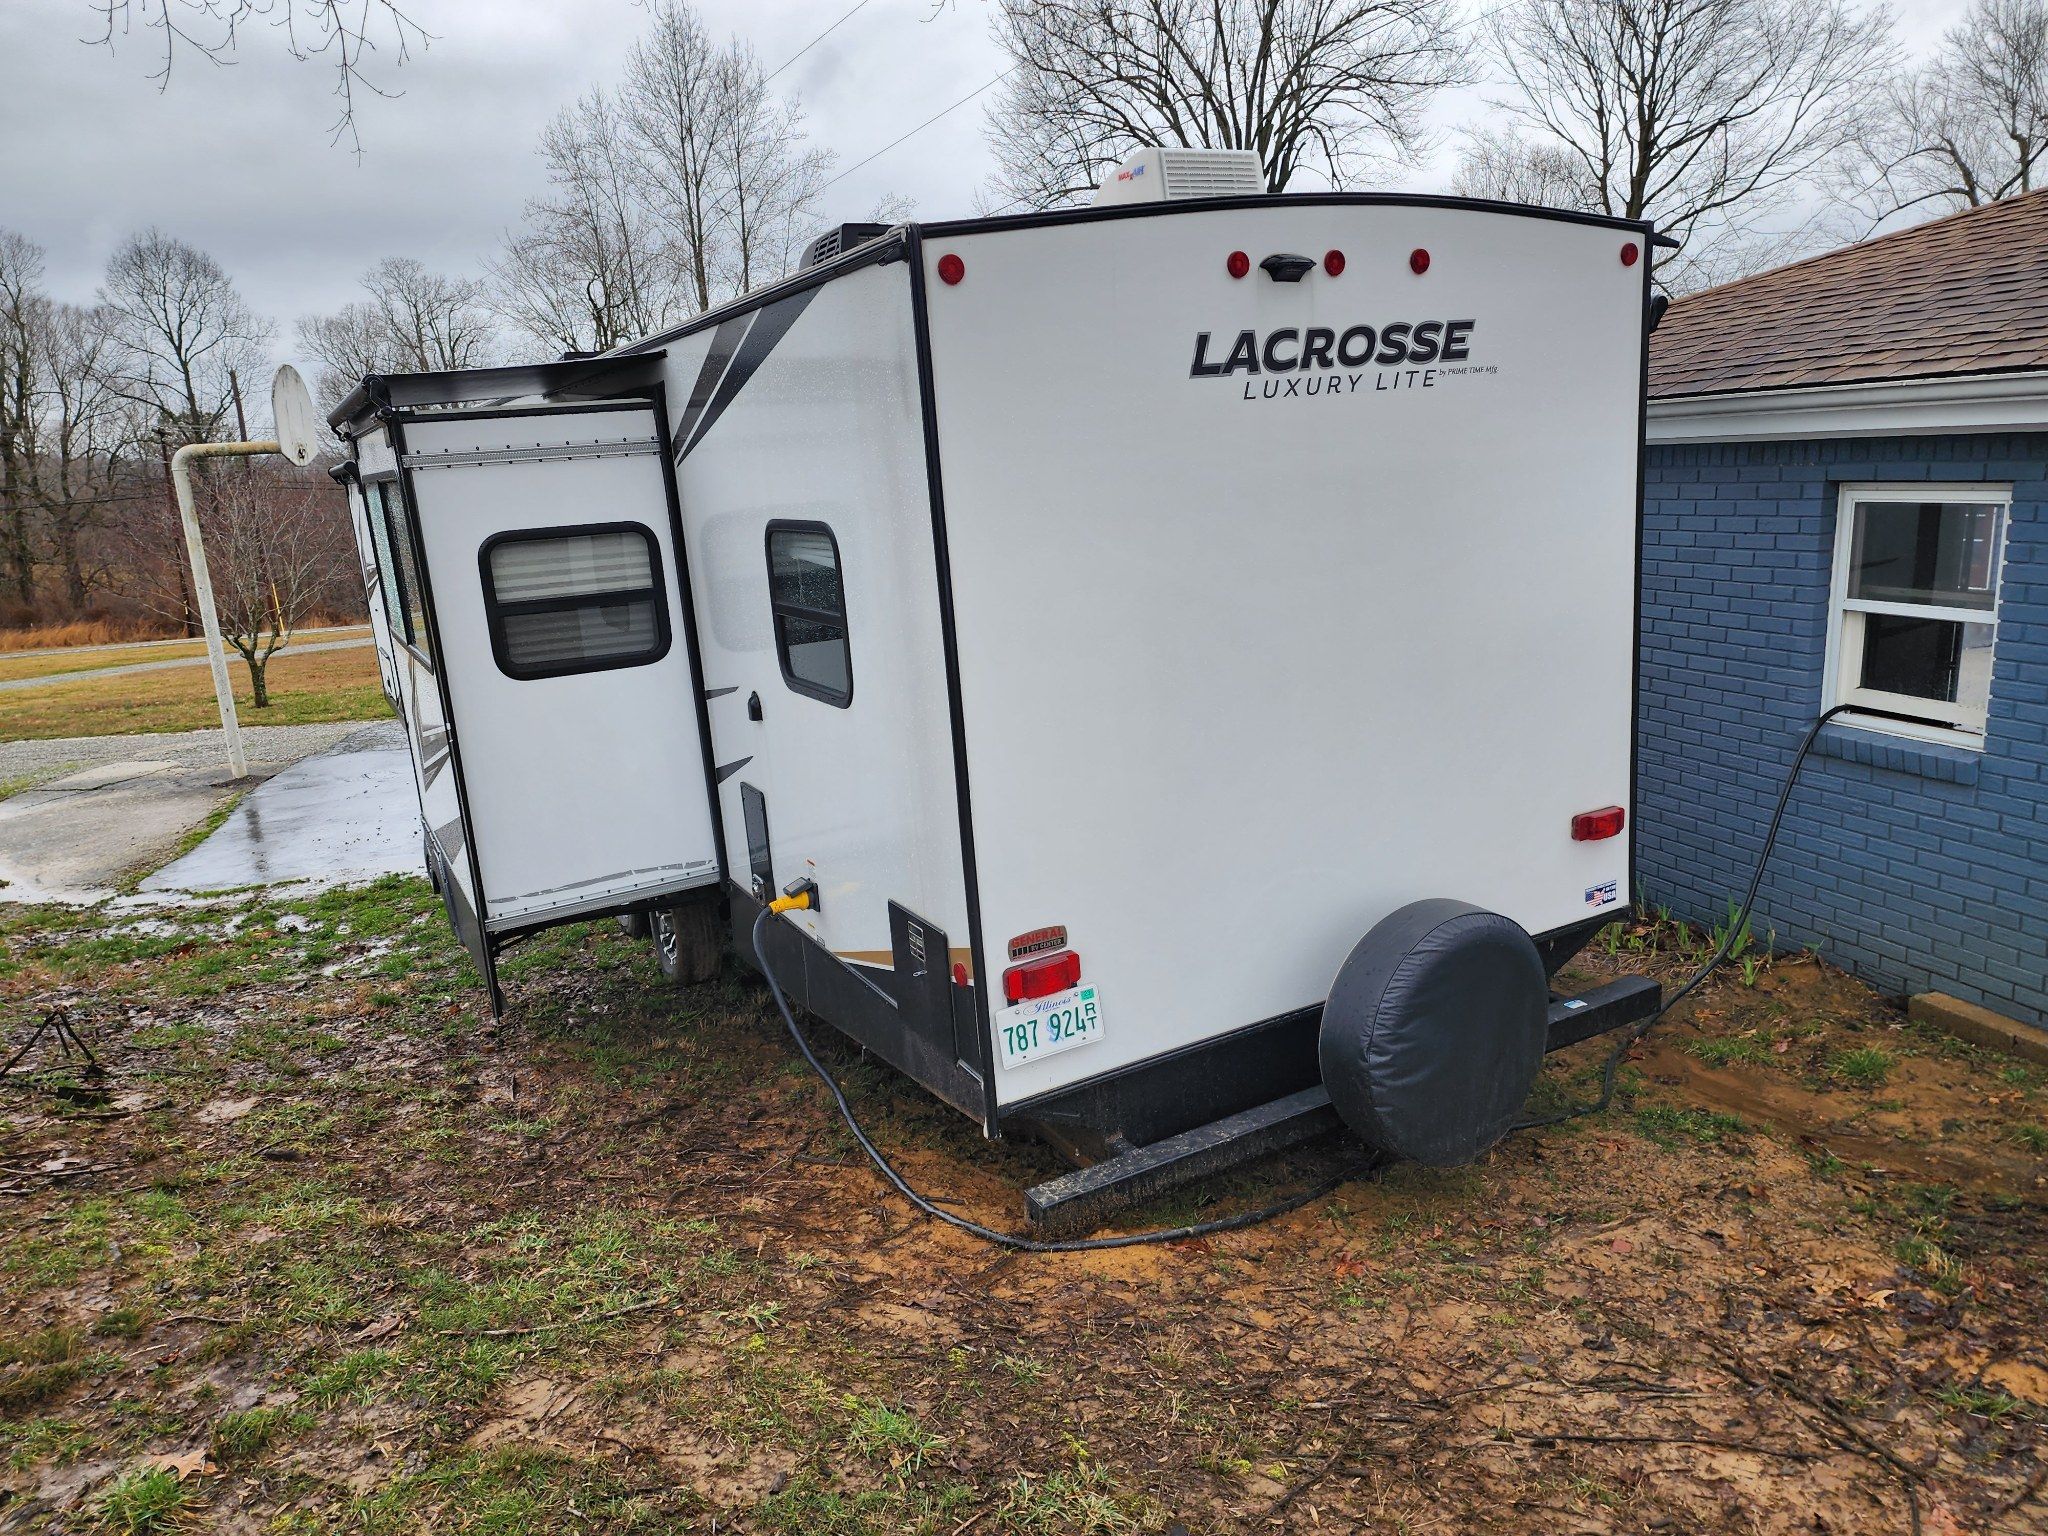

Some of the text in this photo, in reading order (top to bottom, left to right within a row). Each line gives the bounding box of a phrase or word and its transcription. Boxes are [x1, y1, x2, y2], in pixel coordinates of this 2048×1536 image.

[1189, 318, 1476, 379] LACROSSE
[1439, 369, 1446, 377] by
[1447, 367, 1467, 375] PRIME
[1469, 366, 1484, 374] TIME
[1243, 369, 1438, 400] LUXURY LITE
[1603, 890, 1616, 901] USA
[1012, 927, 1064, 948] GENERAL
[1039, 938, 1062, 949] CENTER
[1033, 996, 1072, 1014] Illinois
[1003, 1006, 1087, 1055] 787 924
